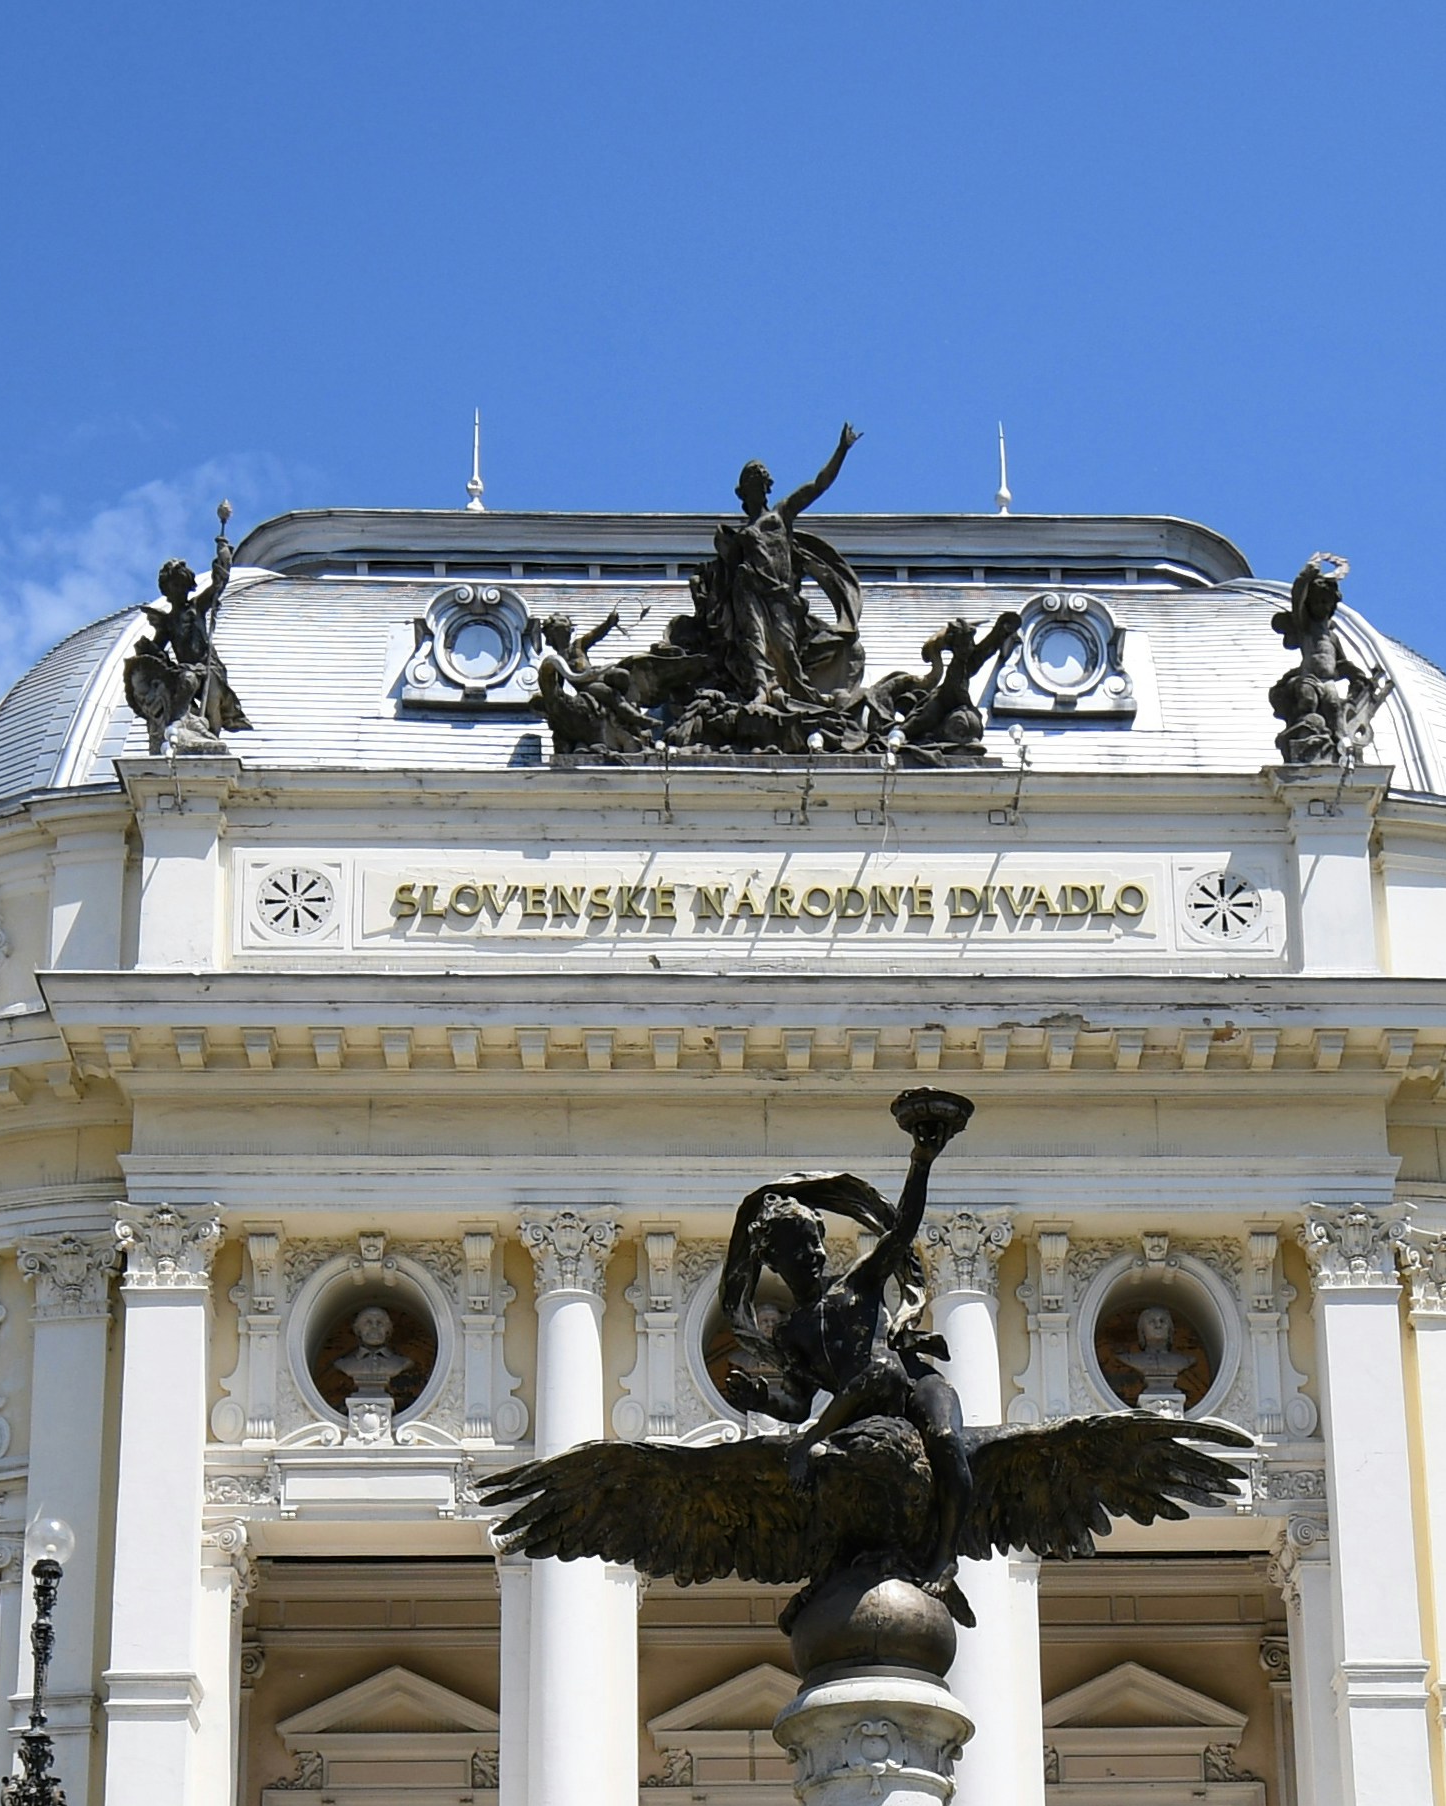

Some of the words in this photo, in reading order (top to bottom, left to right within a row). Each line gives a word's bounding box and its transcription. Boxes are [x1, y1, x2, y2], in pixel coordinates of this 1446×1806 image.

[394, 876, 677, 919] SLOVENSKÉ
[697, 876, 935, 919] NÁRODNÉ
[947, 882, 1150, 918] DIVADLO
